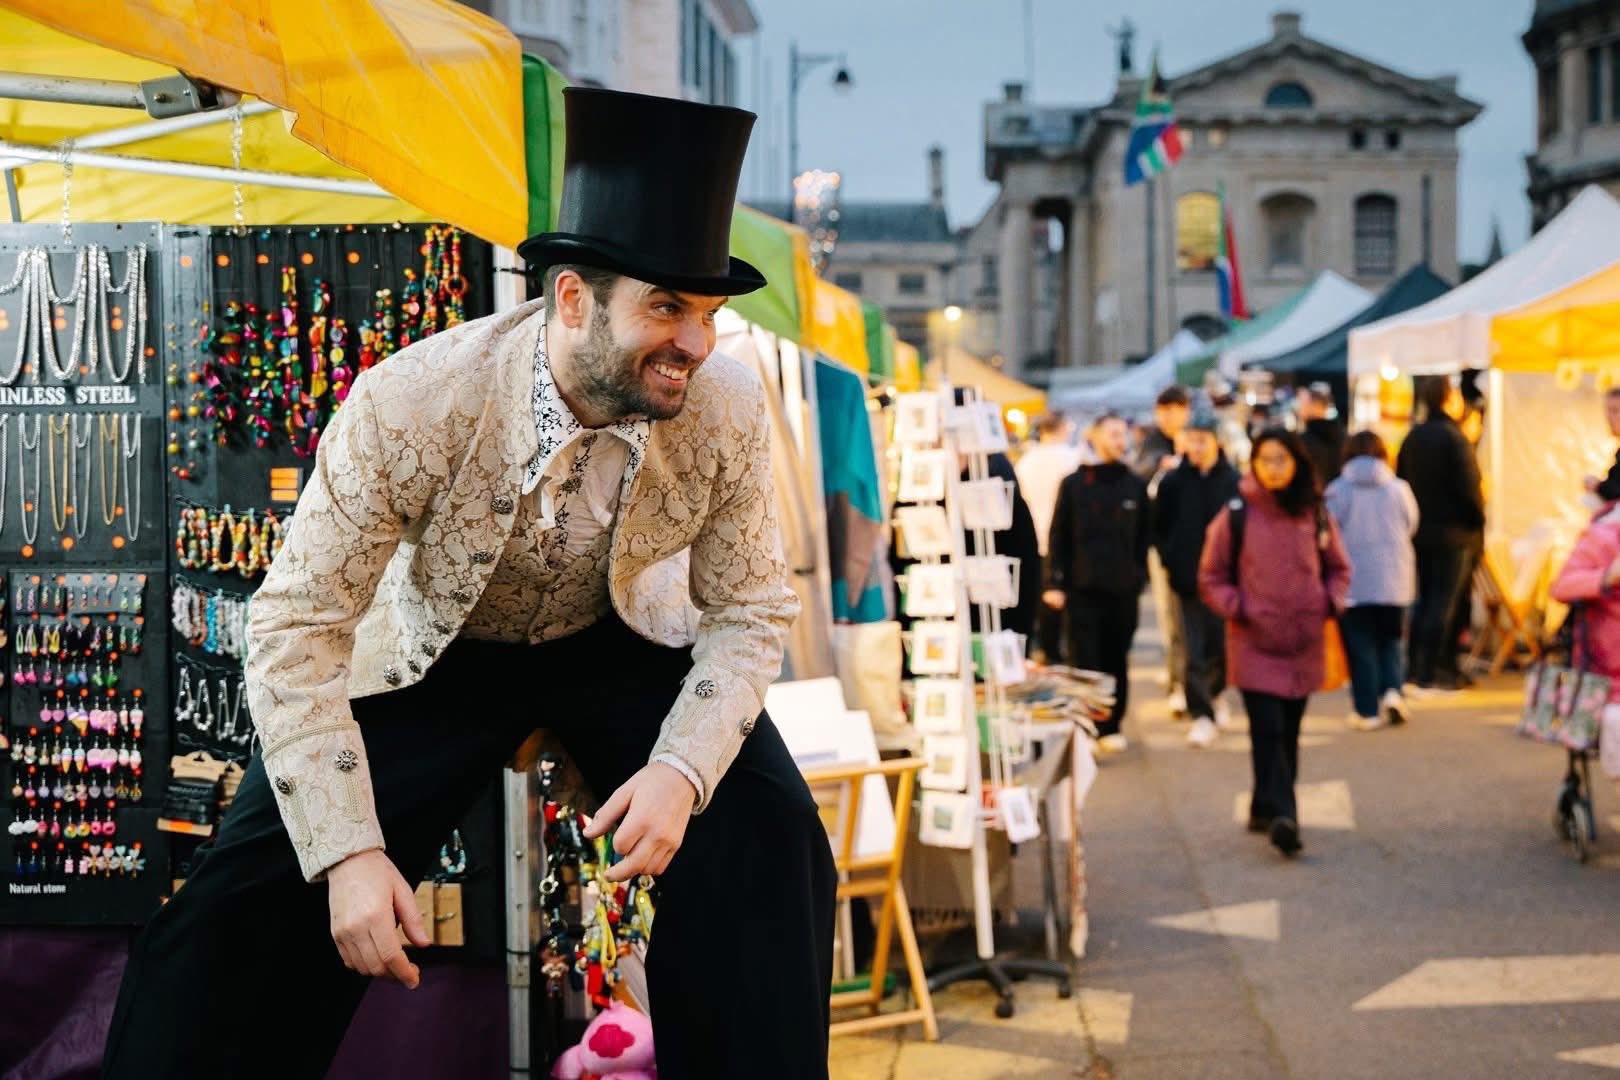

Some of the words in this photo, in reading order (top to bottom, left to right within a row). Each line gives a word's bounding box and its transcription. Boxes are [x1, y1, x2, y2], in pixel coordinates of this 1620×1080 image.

[0, 386, 66, 405] INLESS
[76, 385, 136, 404] STEEL
[9, 882, 41, 894] Natural
[43, 883, 66, 894] stone
